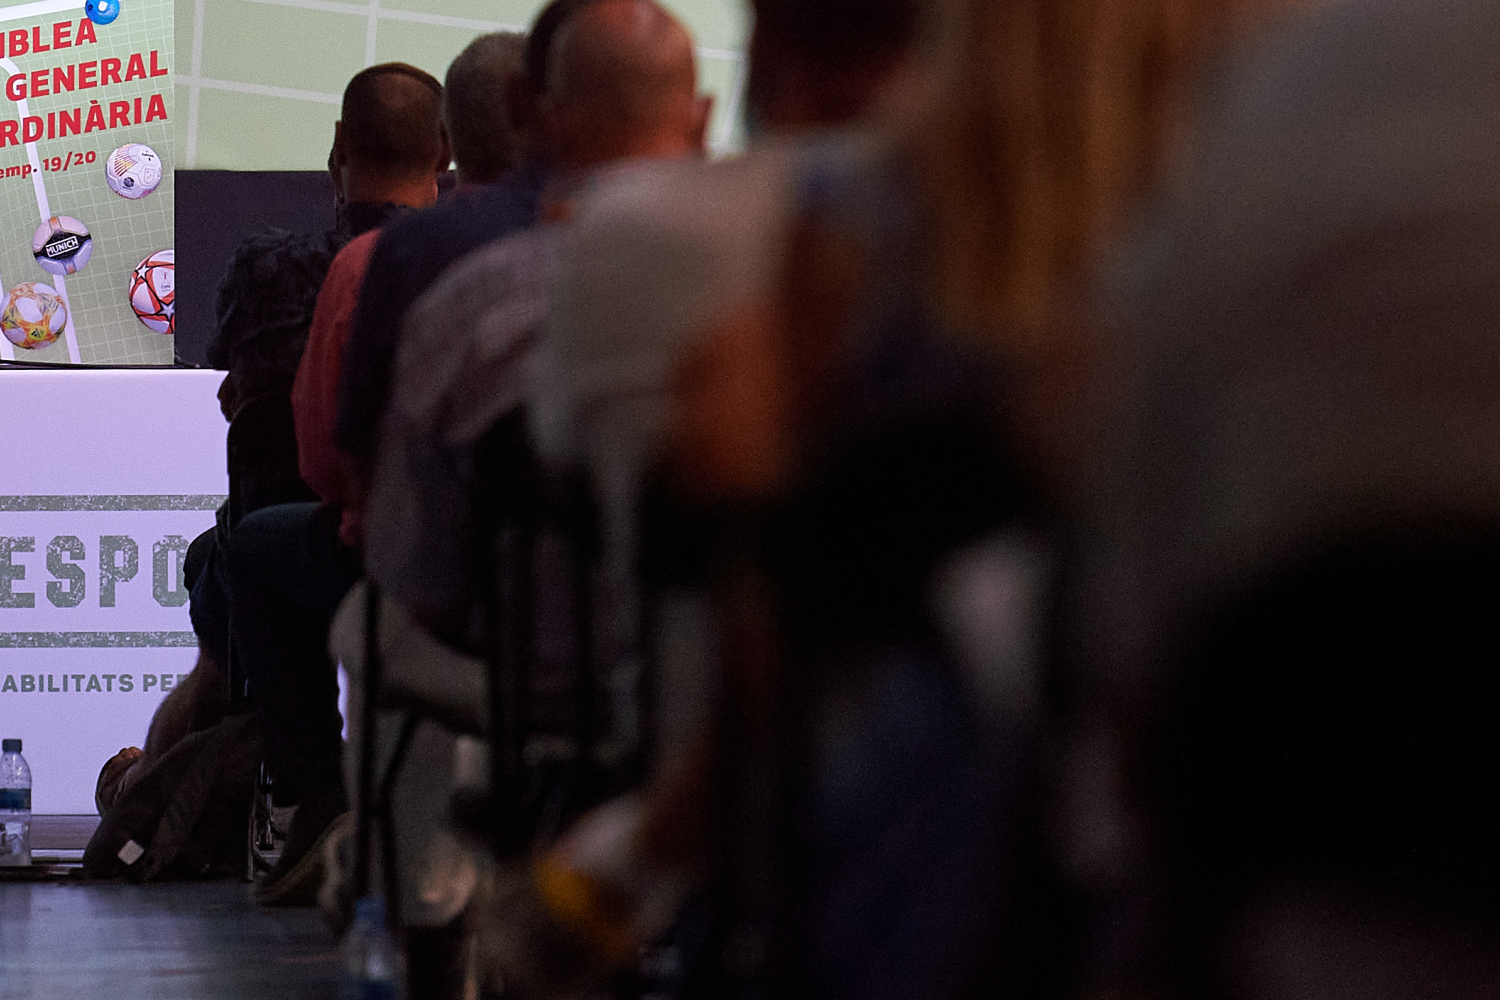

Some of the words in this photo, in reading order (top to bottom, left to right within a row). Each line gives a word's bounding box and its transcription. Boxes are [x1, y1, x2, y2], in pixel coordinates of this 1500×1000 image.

[6, 50, 168, 101] GENERAL
[43, 150, 96, 172] 19/20
[46, 239, 78, 254] MUNICH
